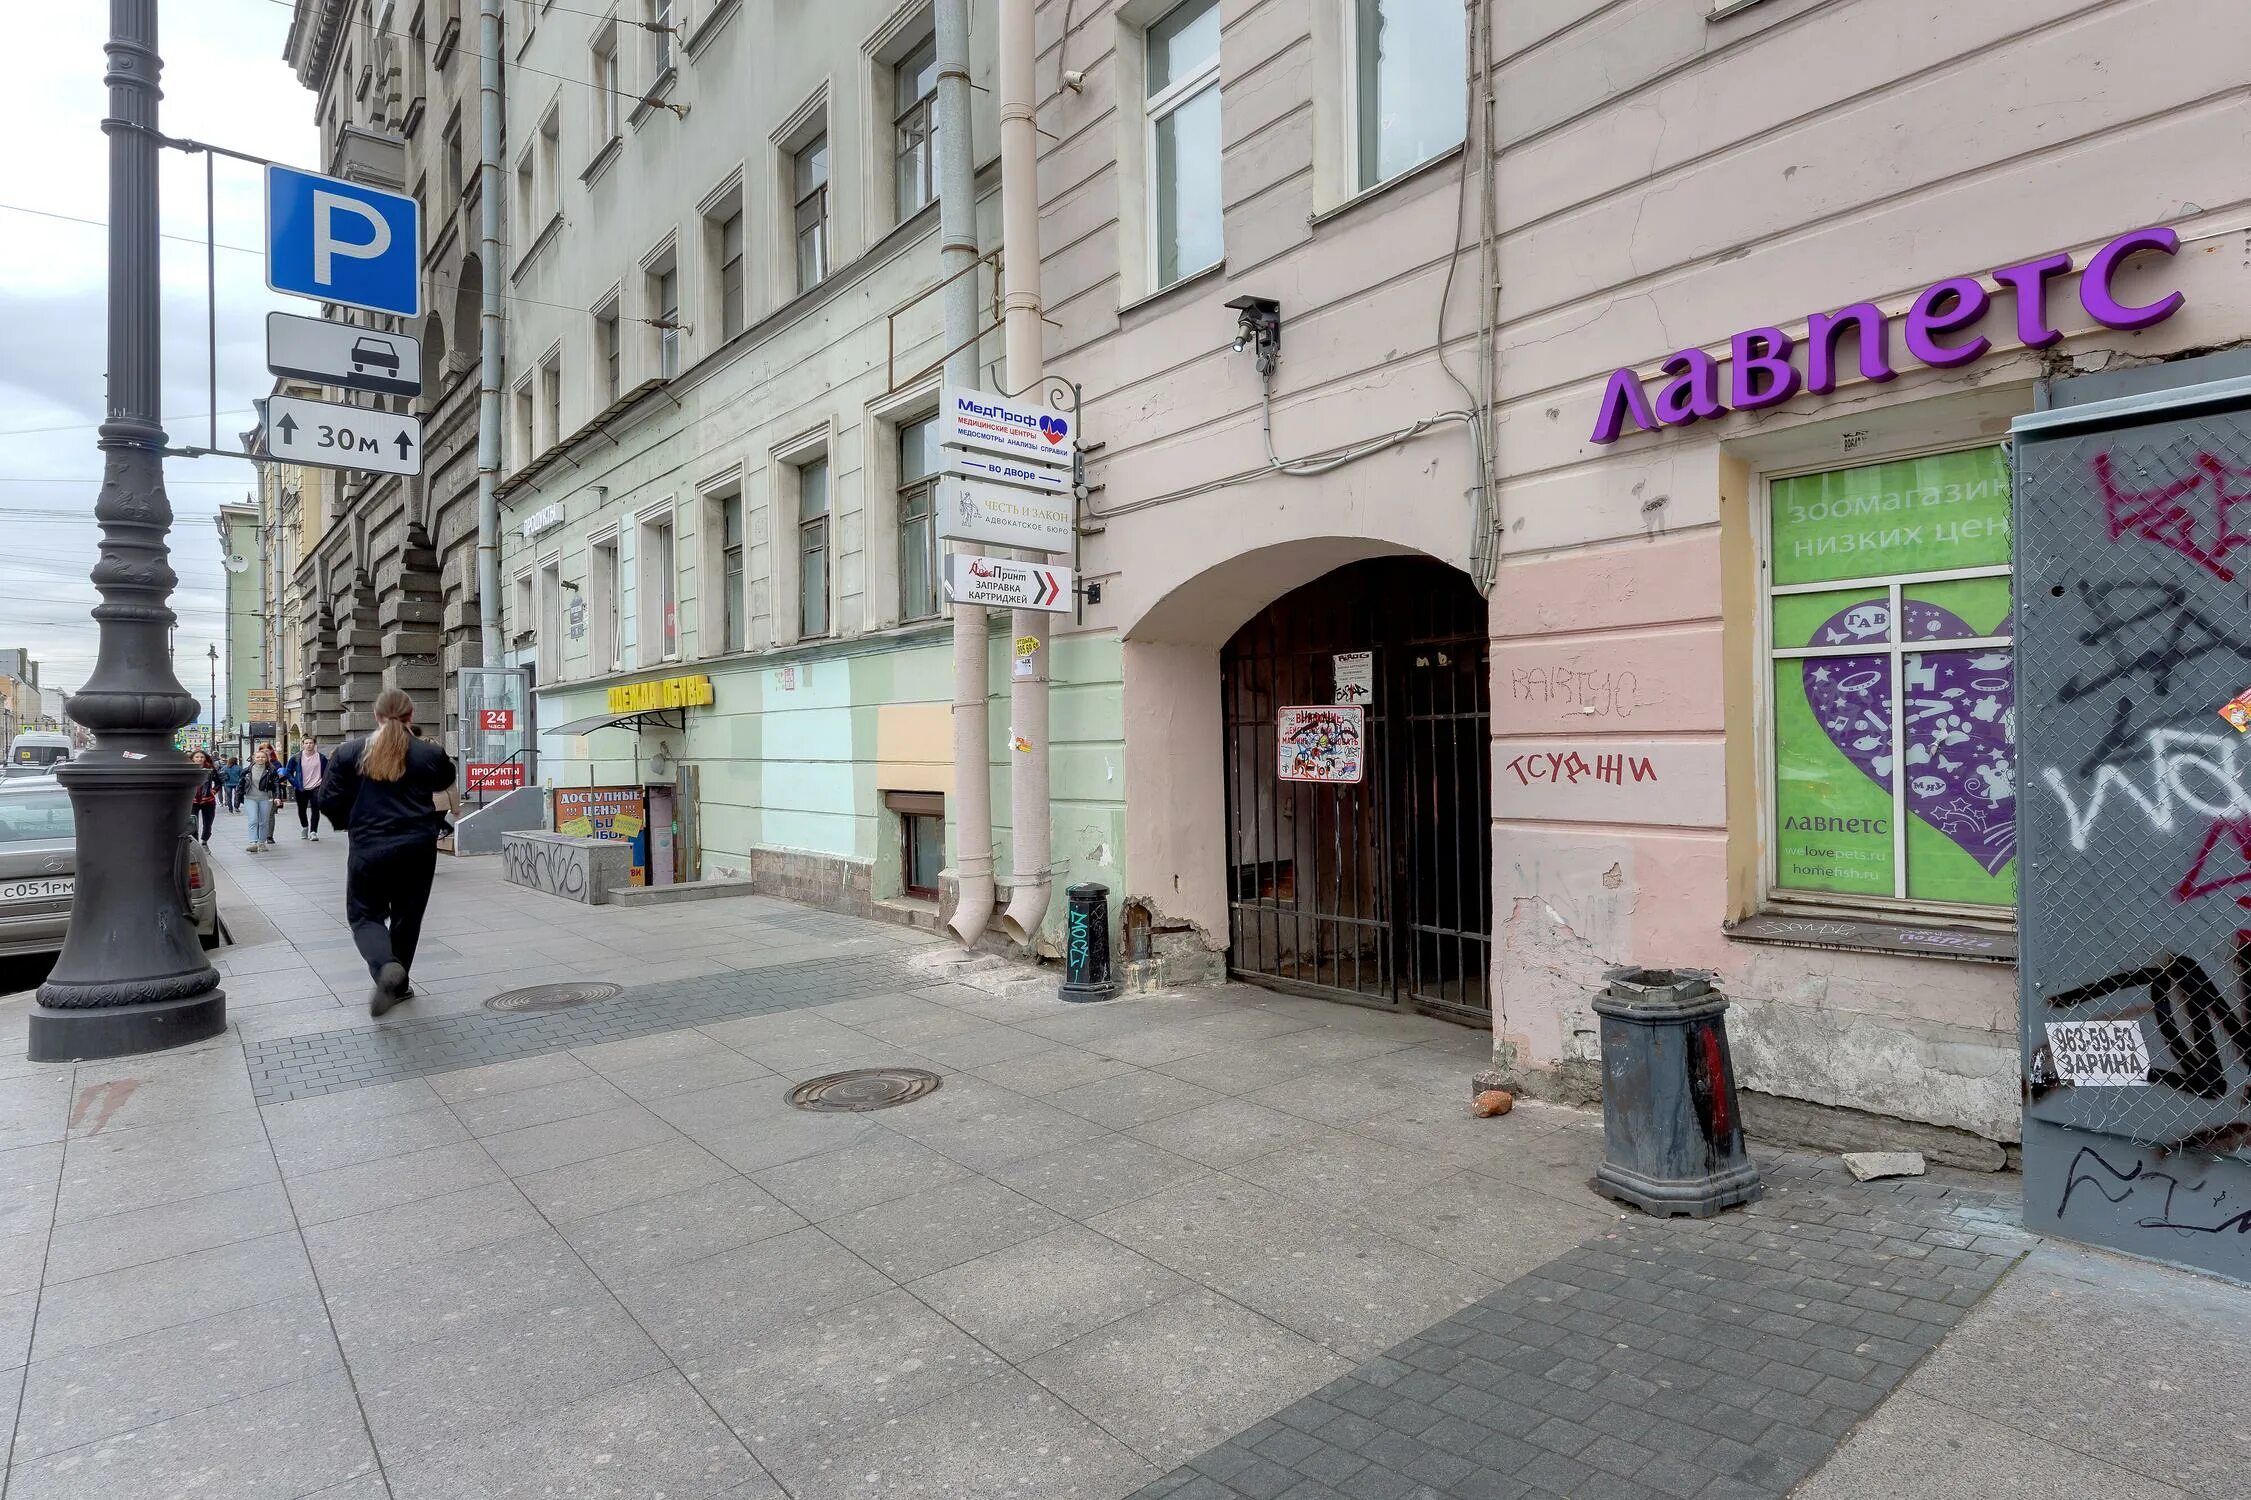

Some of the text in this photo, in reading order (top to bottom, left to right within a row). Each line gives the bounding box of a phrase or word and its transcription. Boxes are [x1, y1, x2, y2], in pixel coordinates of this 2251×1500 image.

[314, 189, 391, 286] P
[958, 398, 1037, 428] МедПроф
[958, 416, 1037, 440] МЕДИЦИНСКИЕ ЦЕНТРЫ
[958, 428, 1068, 457] МЕДОСМОТРЫ АНАЛИЗЫ СПРАВКИ
[988, 463, 1036, 480] во дворе
[984, 500, 1069, 523] ЧЕСТЬ И ЗАКОН
[985, 516, 1069, 535] АДВОКАТСКОЕ БЮРО
[1794, 525, 1922, 560] низких
[976, 580, 1021, 592] ЗАПРАВКА
[968, 591, 1028, 604] КАРТРИДЖЕЙ
[1847, 613, 1886, 628] ГАВ
[486, 711, 507, 724] 24
[471, 768, 520, 777] ПРОДУКТЫ
[1913, 782, 1945, 791] МЯУ
[1785, 816, 1887, 834] лавпетс
[1785, 845, 1886, 861] welovepets.ru
[1793, 863, 1879, 880] homefish.ru
[2055, 1027, 2136, 1052] 963-59-53
[2061, 1053, 2145, 1074] ЗАРИНА
